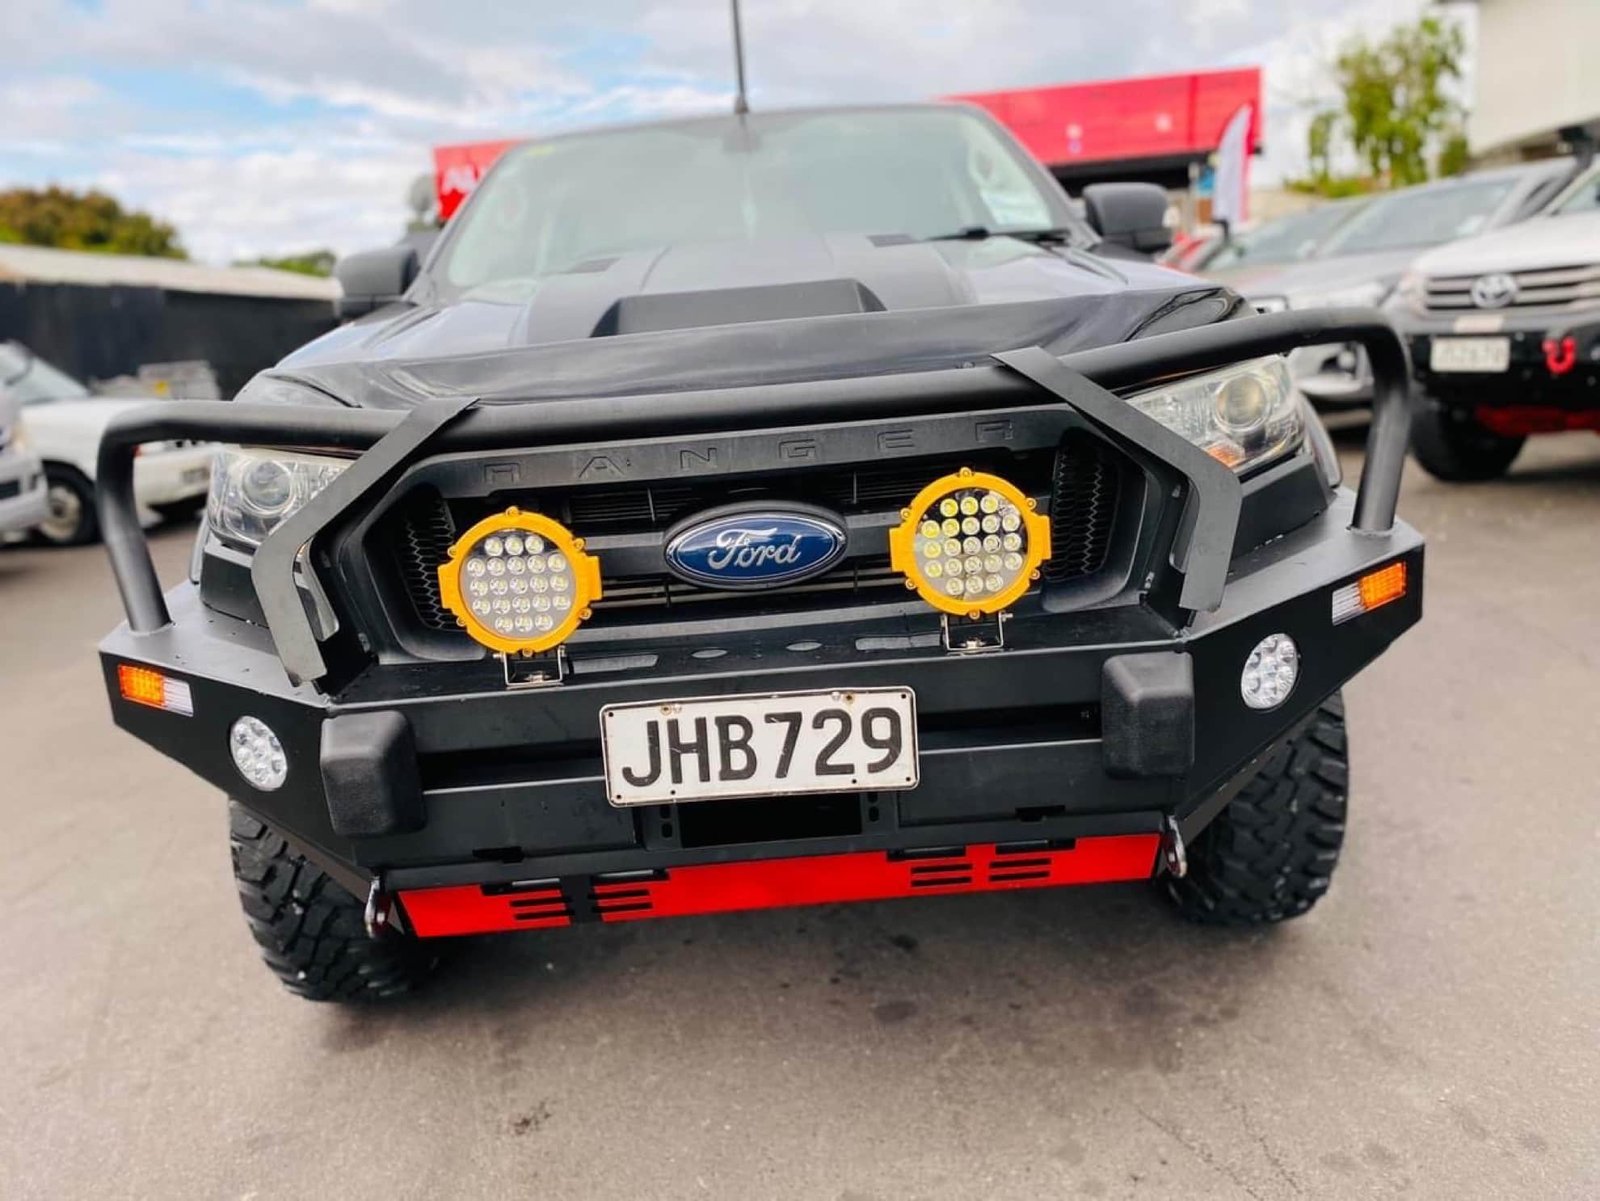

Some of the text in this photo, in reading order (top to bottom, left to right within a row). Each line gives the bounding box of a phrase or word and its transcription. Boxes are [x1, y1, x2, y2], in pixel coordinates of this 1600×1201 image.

[484, 419, 1014, 483] RANGER
[707, 527, 802, 570] Ford
[621, 707, 901, 787] JHB729
